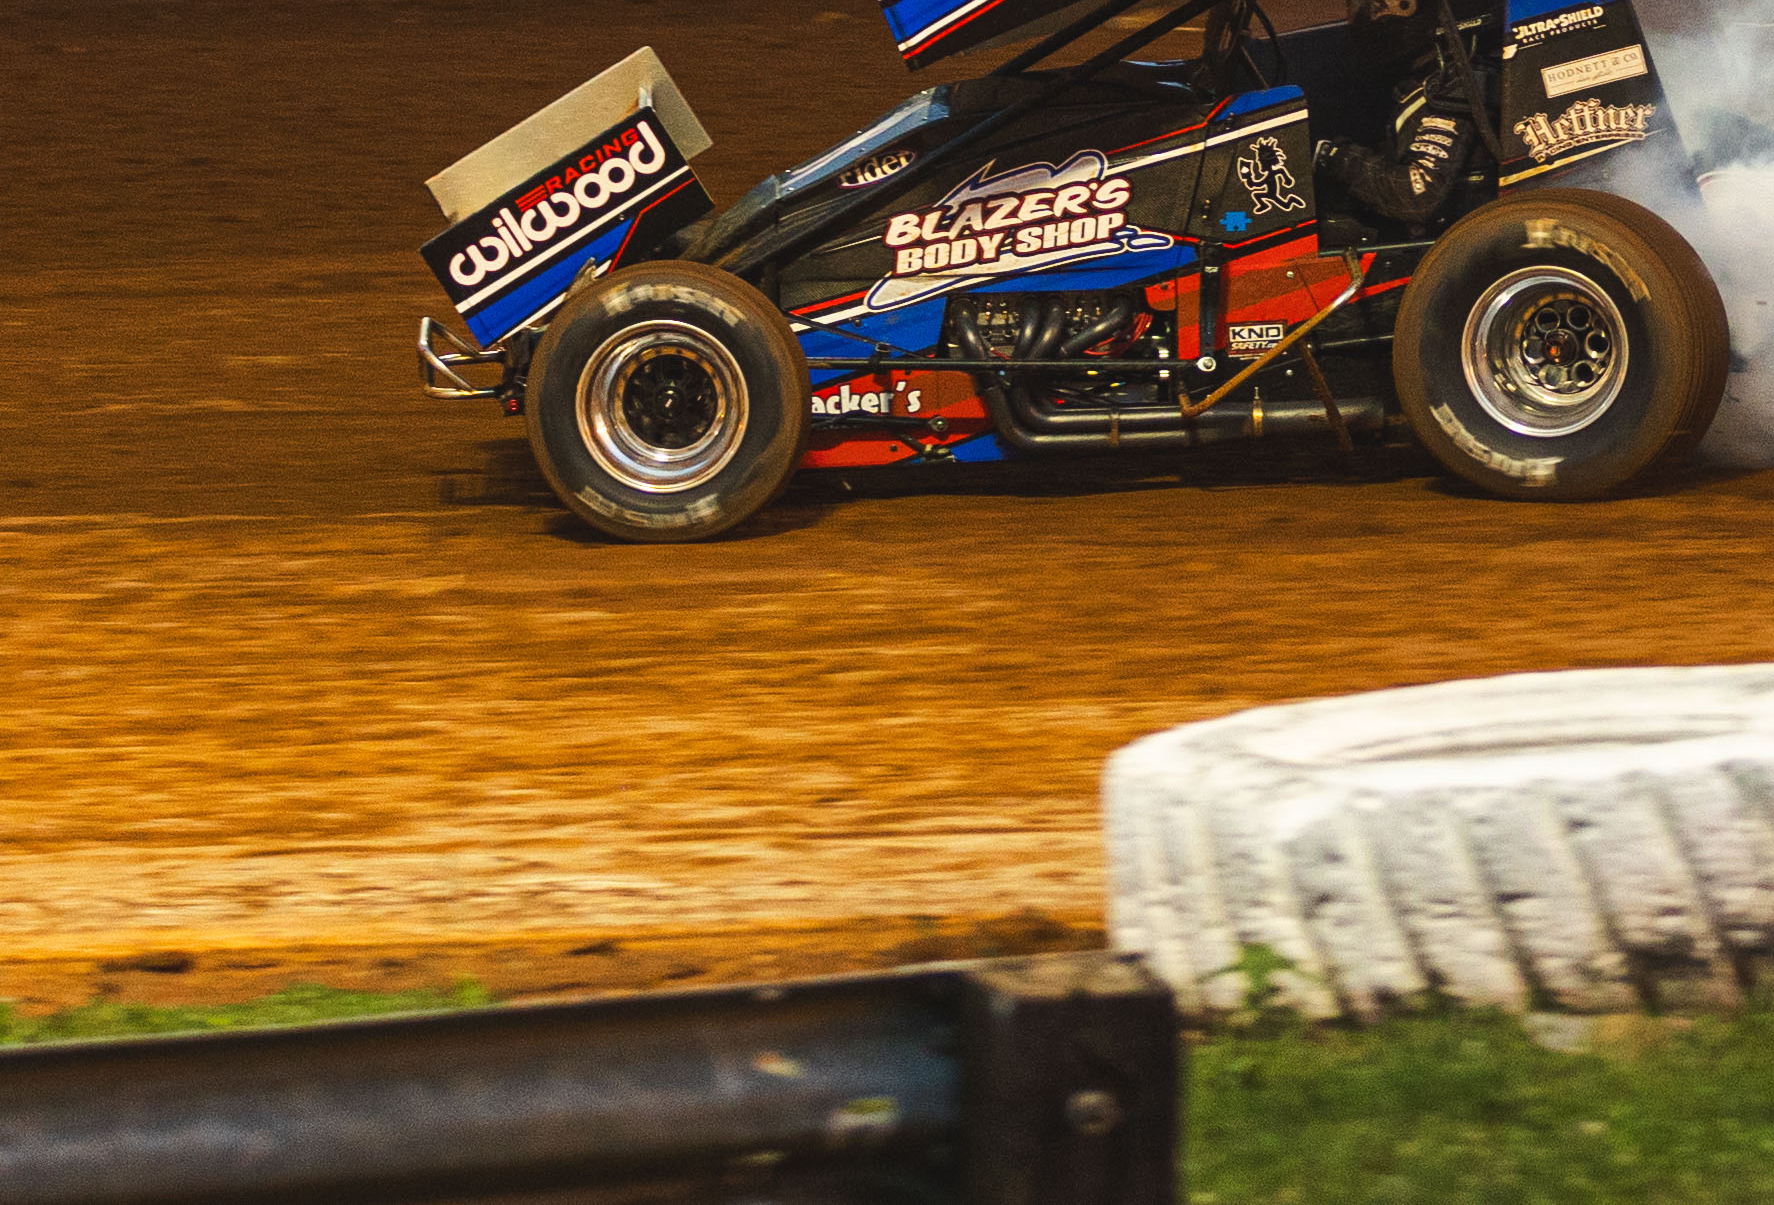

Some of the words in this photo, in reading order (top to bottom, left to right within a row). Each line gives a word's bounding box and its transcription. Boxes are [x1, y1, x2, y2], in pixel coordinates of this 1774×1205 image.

[1522, 33, 1545, 44] RACE
[1549, 19, 1599, 36] PRODUCTS
[1547, 59, 1608, 83] HODNETT
[1514, 98, 1656, 156] Heffner
[1536, 139, 1574, 163] RCING
[545, 127, 639, 195] RACING
[449, 120, 666, 286] wilwood
[886, 178, 1130, 245] BLAZER'S
[896, 232, 1003, 276] BODY
[1015, 212, 1125, 253] SHOP
[1231, 326, 1281, 340] KND
